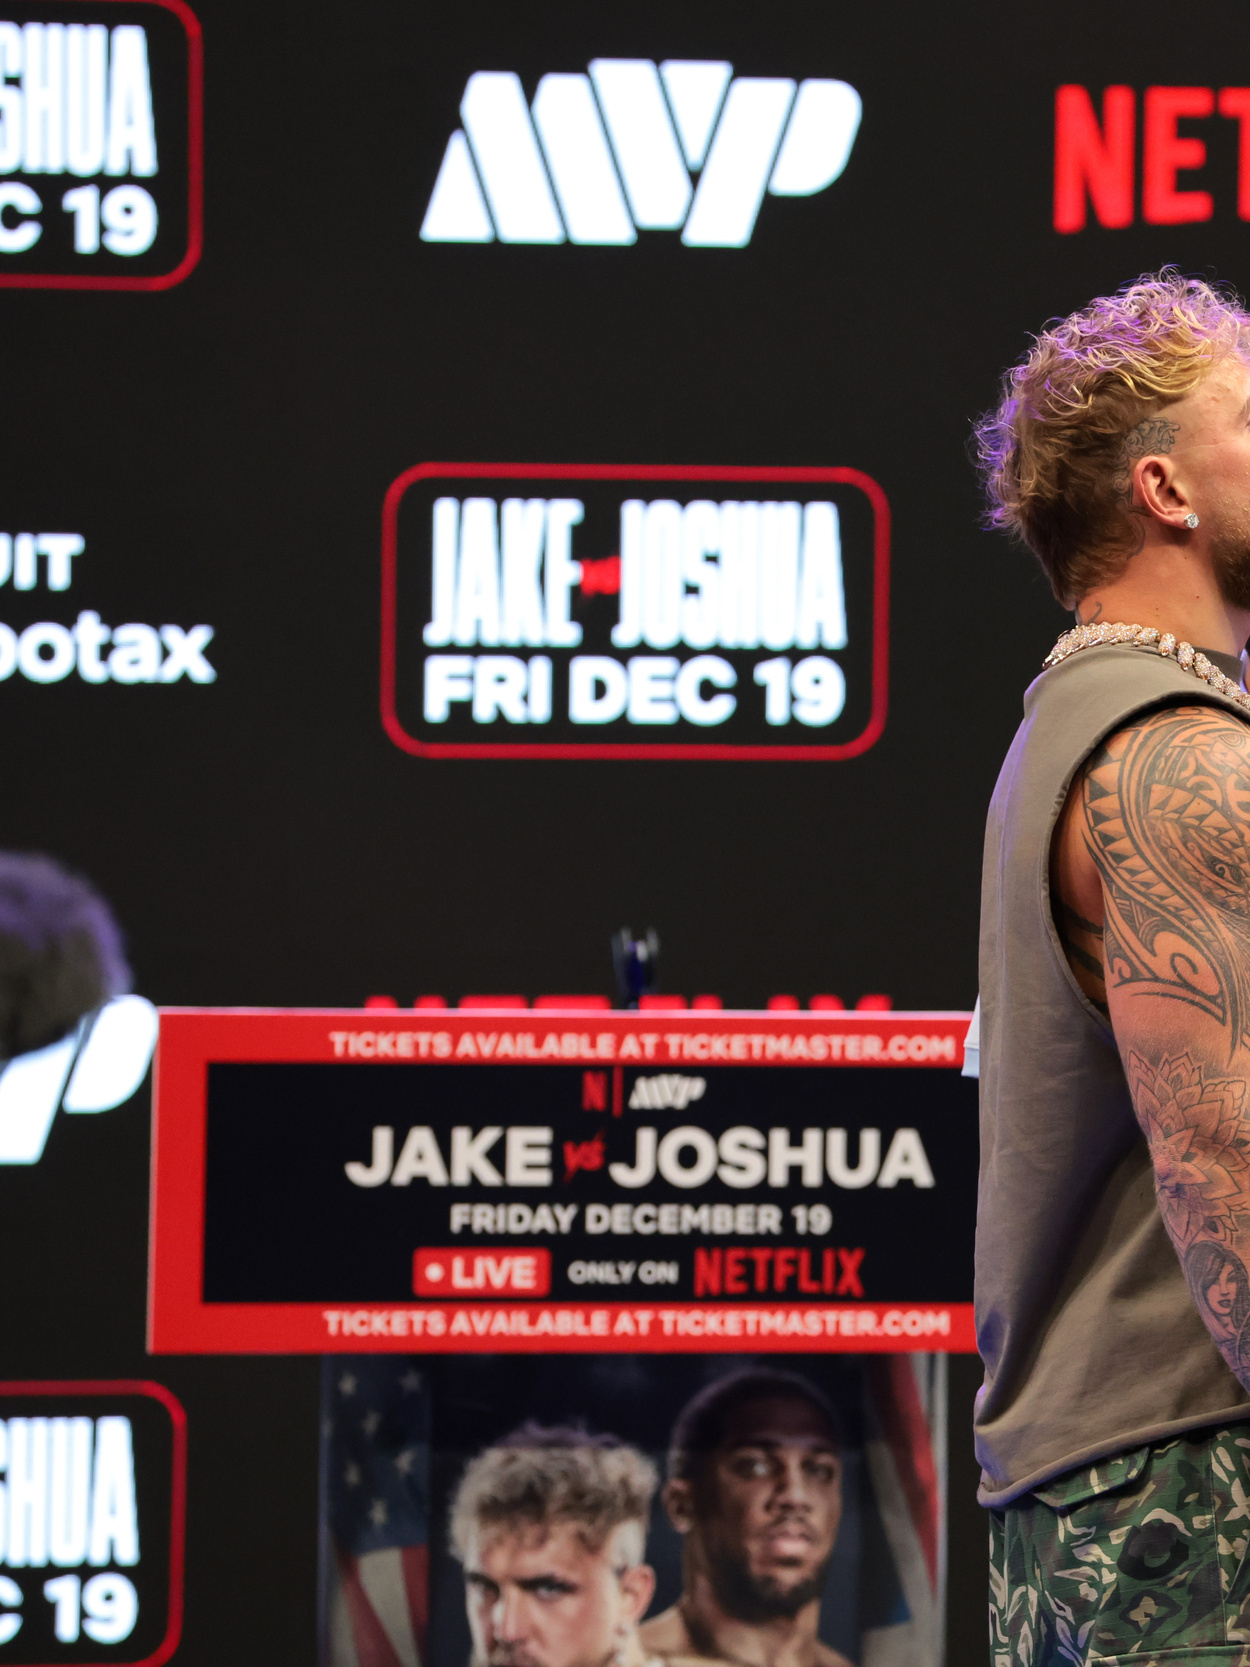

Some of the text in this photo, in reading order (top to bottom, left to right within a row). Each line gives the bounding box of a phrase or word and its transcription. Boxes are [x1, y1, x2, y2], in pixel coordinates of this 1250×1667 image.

[419, 57, 863, 248] MVP
[62, 184, 158, 256] 19
[0, 532, 85, 591] IT
[422, 496, 847, 650] JAKE JOSHUA
[423, 654, 846, 727] FRI DEC 19
[329, 1031, 956, 1061] TICKETS AVAILABLE AT TICKETMASTER.COM
[629, 1073, 707, 1110] MVP
[345, 1126, 553, 1187] JAKE
[609, 1126, 935, 1189] JOSHUA
[450, 1203, 833, 1236] FRIDAY DECEMBER 19
[451, 1247, 866, 1298] LIVE ONLY ON NETFLIX
[323, 1310, 951, 1337] TICKETS AVAILABLE AT TICKETMASTER.COM
[0, 1415, 140, 1567] HUA
[43, 1572, 139, 1644] 19
